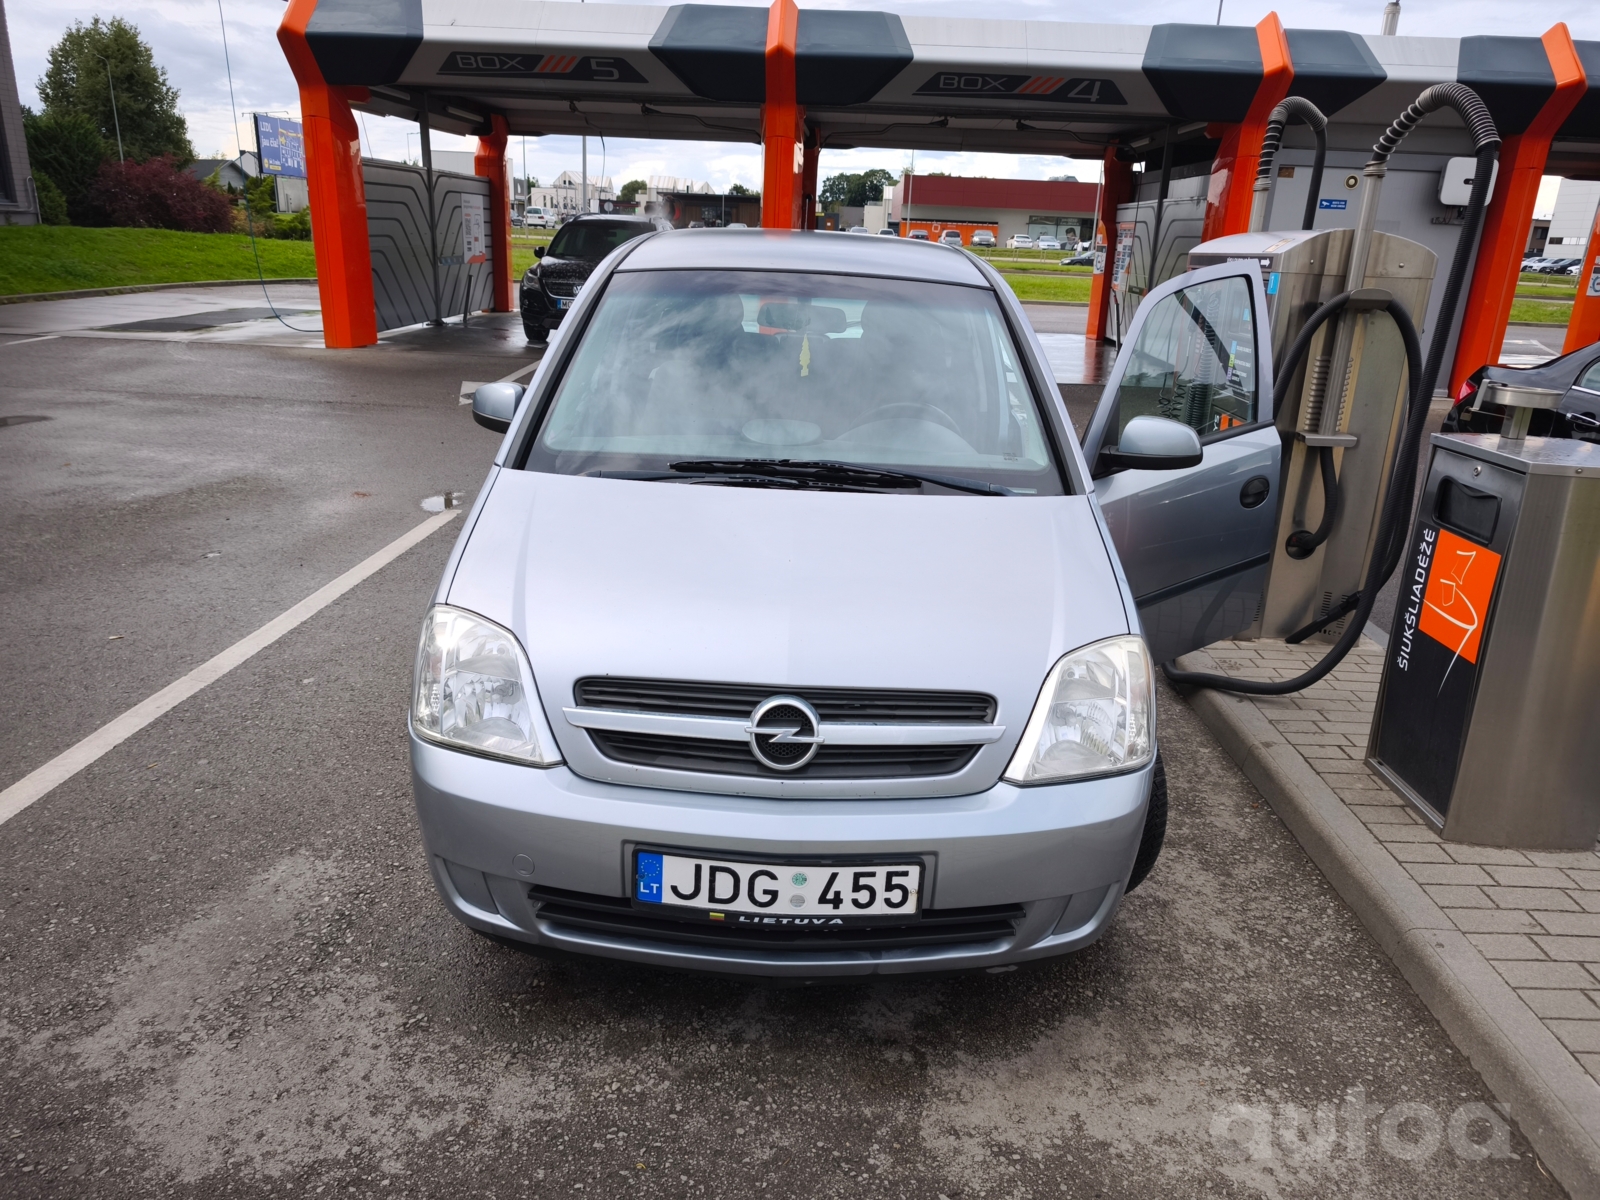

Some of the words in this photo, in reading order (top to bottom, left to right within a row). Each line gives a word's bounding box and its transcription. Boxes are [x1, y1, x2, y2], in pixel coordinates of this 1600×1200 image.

[456, 54, 525, 70] BOX
[590, 58, 619, 80] 5
[939, 74, 1008, 91] BOX
[1067, 80, 1101, 102] 4
[1397, 528, 1435, 671] ŠIUKŠLIADĖŽĖ
[640, 881, 660, 894] LT
[670, 863, 779, 908] JDG
[817, 870, 910, 910] 455
[738, 915, 844, 925] LIETUVA
